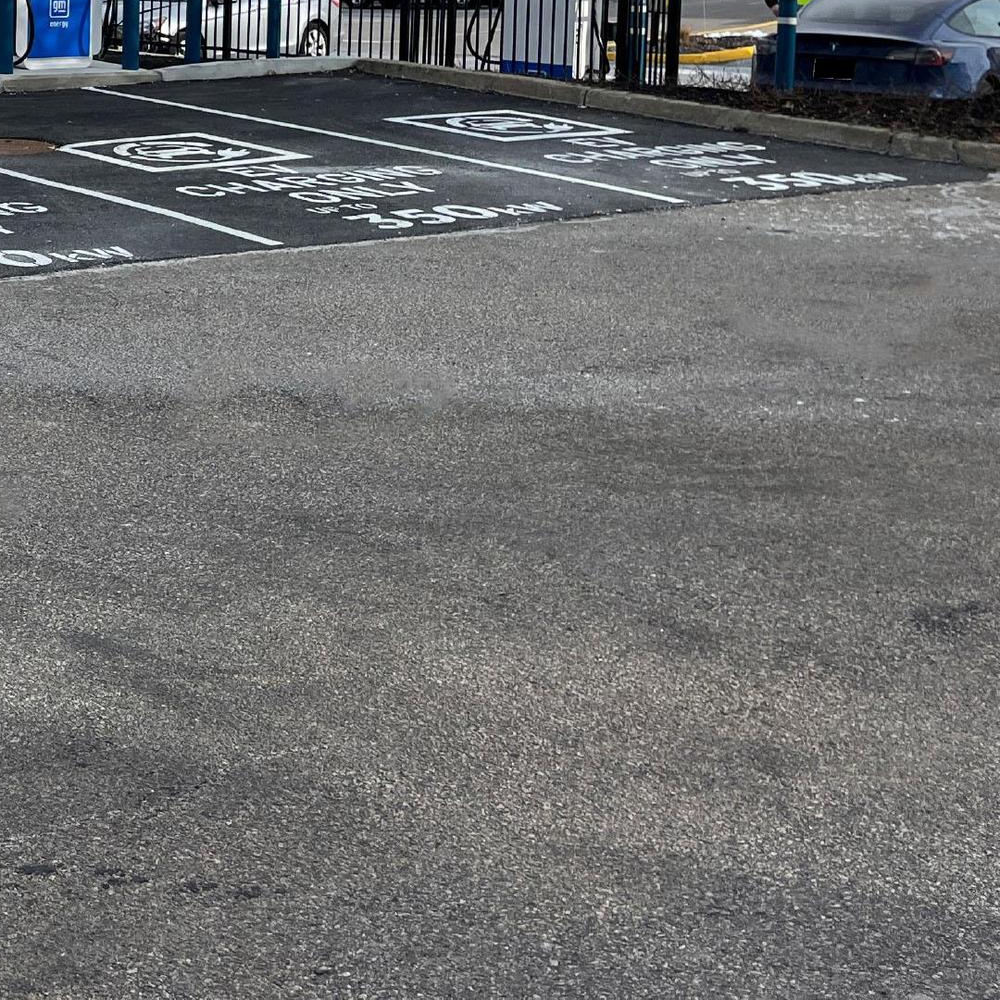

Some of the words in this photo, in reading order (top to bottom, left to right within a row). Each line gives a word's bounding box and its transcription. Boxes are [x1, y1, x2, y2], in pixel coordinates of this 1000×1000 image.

[53, 0, 67, 13] gm
[49, 21, 69, 29] energy
[217, 163, 299, 178] EV
[175, 165, 443, 197] CHARGING
[288, 181, 436, 204] ONLY
